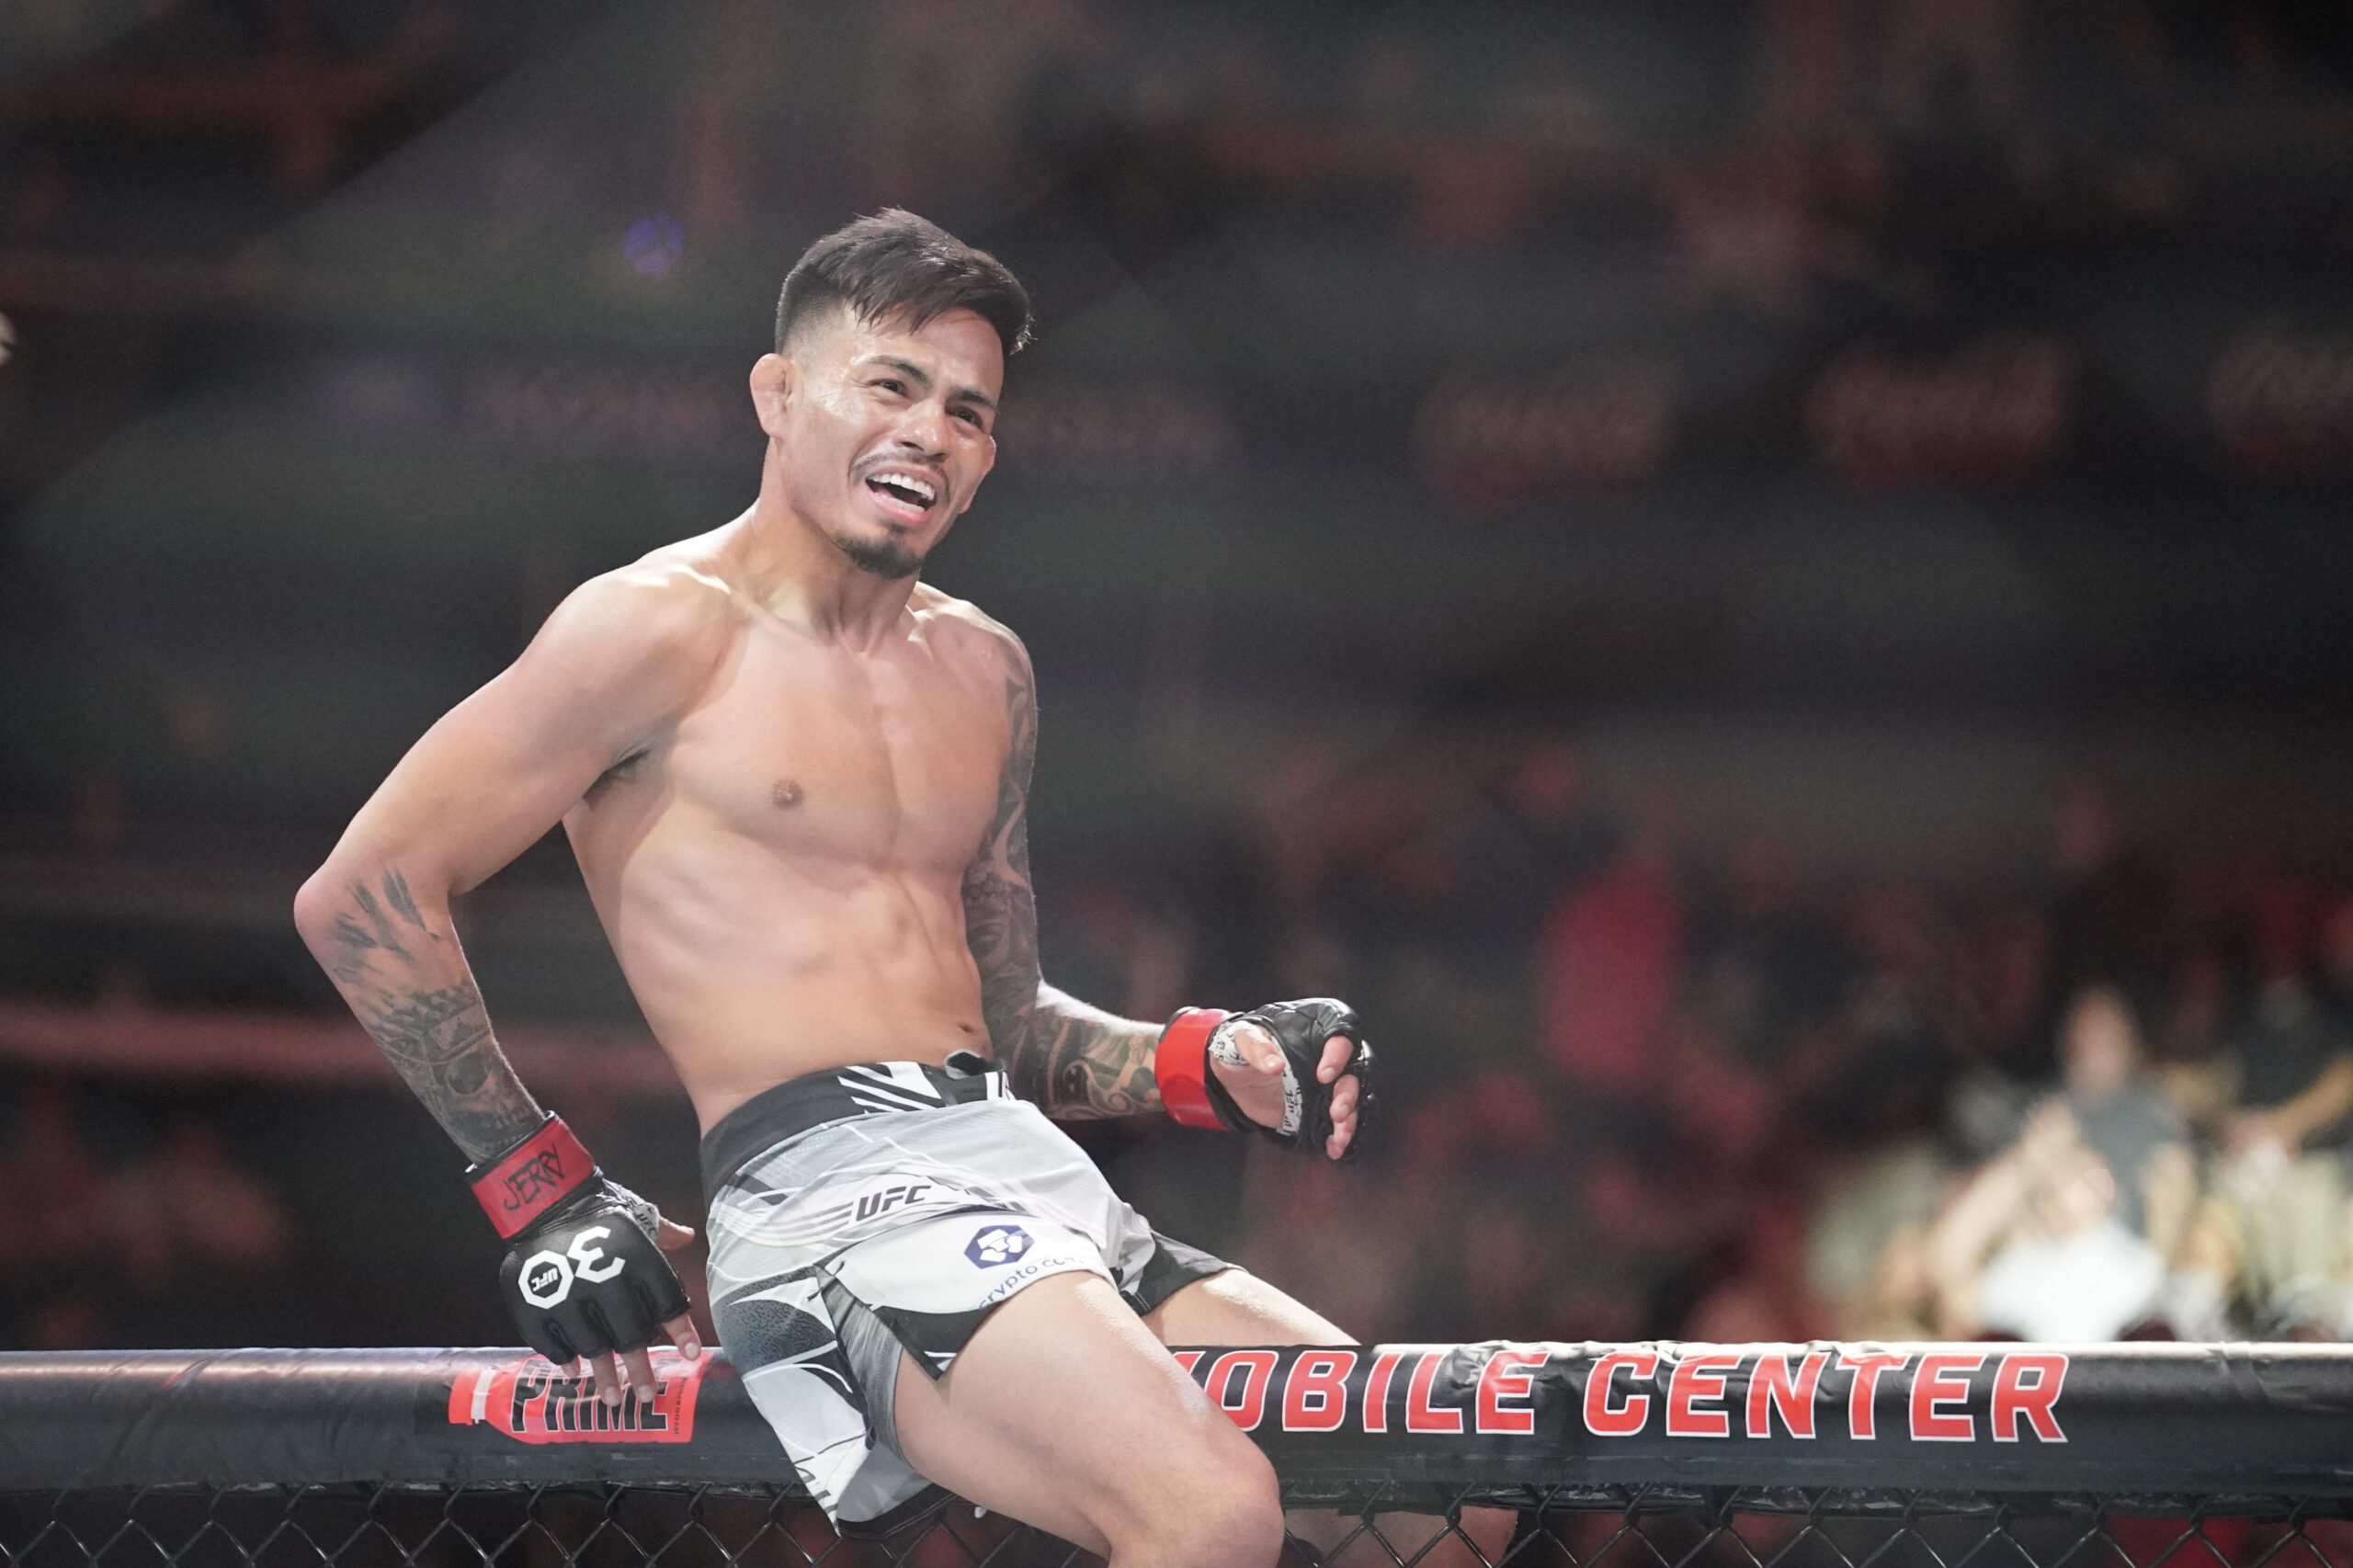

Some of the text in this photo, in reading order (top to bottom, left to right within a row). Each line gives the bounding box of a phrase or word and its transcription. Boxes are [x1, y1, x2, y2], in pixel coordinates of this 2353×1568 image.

[503, 1142, 566, 1210] JERRY
[856, 1185, 932, 1222] UFC
[530, 1267, 559, 1292] UFC
[1583, 1352, 2069, 1443] CENTER
